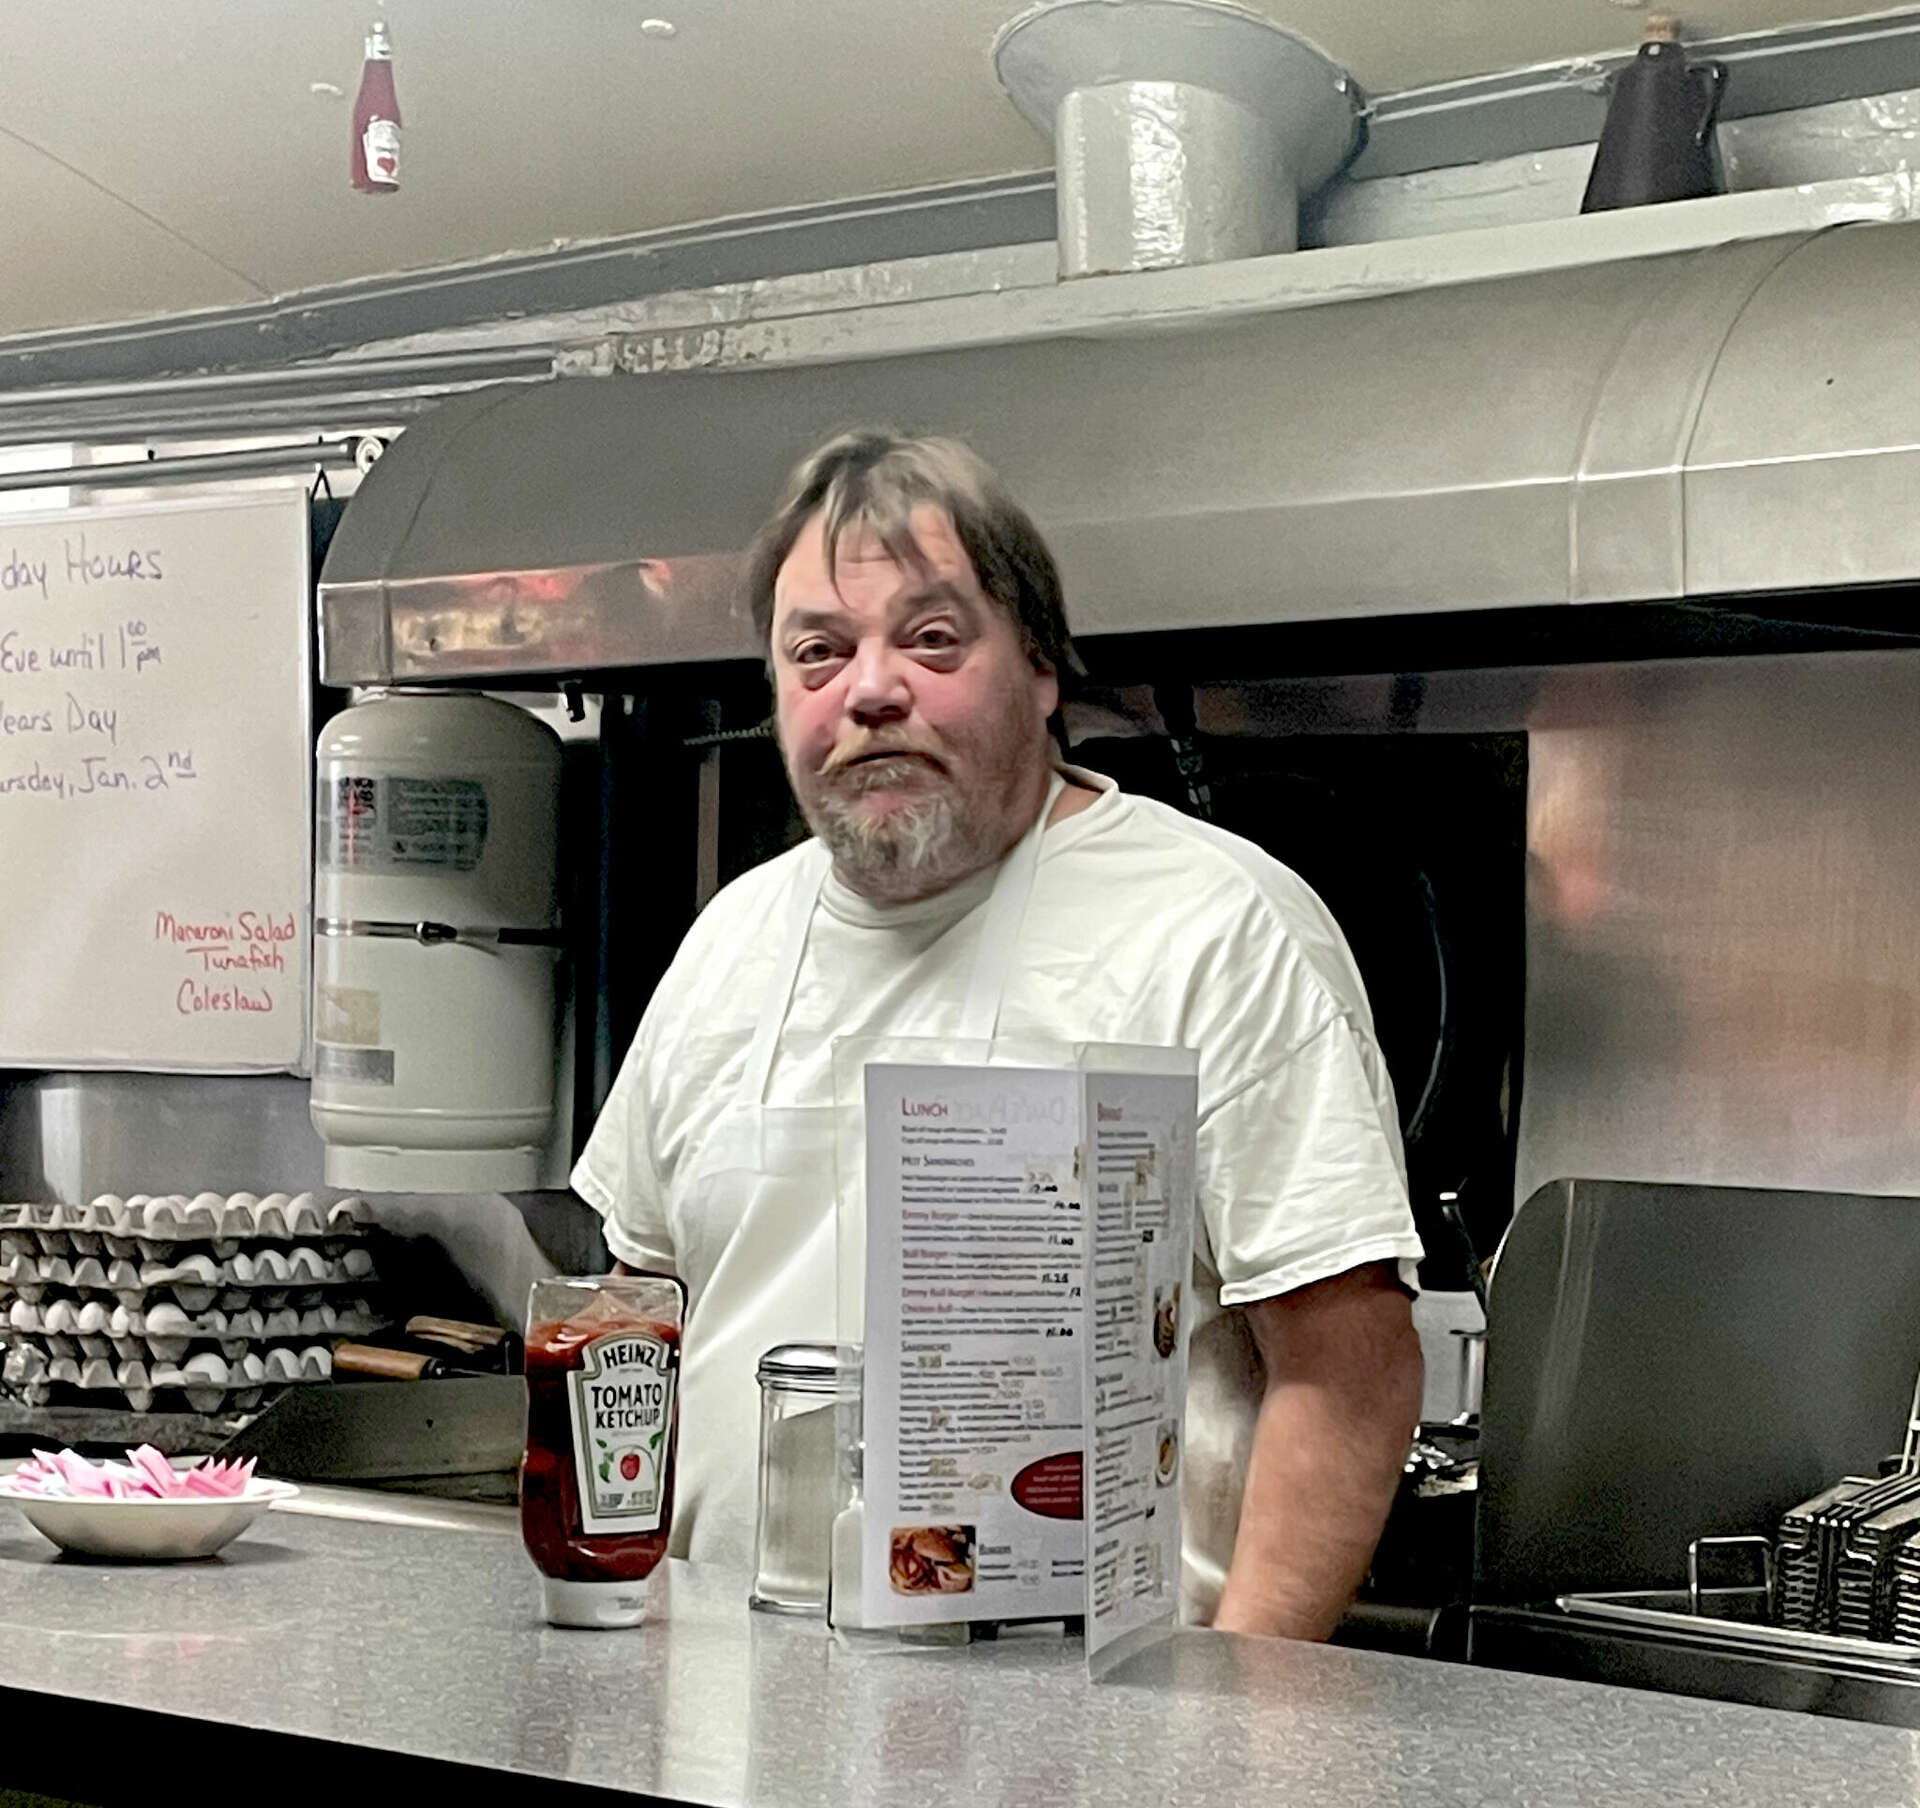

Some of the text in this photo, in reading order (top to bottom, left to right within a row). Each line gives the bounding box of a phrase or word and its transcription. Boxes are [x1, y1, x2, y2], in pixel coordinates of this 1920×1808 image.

[1, 631, 42, 673] Eve
[0, 691, 117, 746] ears Day
[79, 757, 137, 794] Jan.
[239, 911, 296, 942] Salad
[177, 978, 273, 1015] Coleslaw
[902, 1097, 949, 1117] LUNCH
[603, 1344, 656, 1368] HEINZ
[590, 1383, 663, 1409] TOMATO
[595, 1408, 660, 1429] KETCHUP
